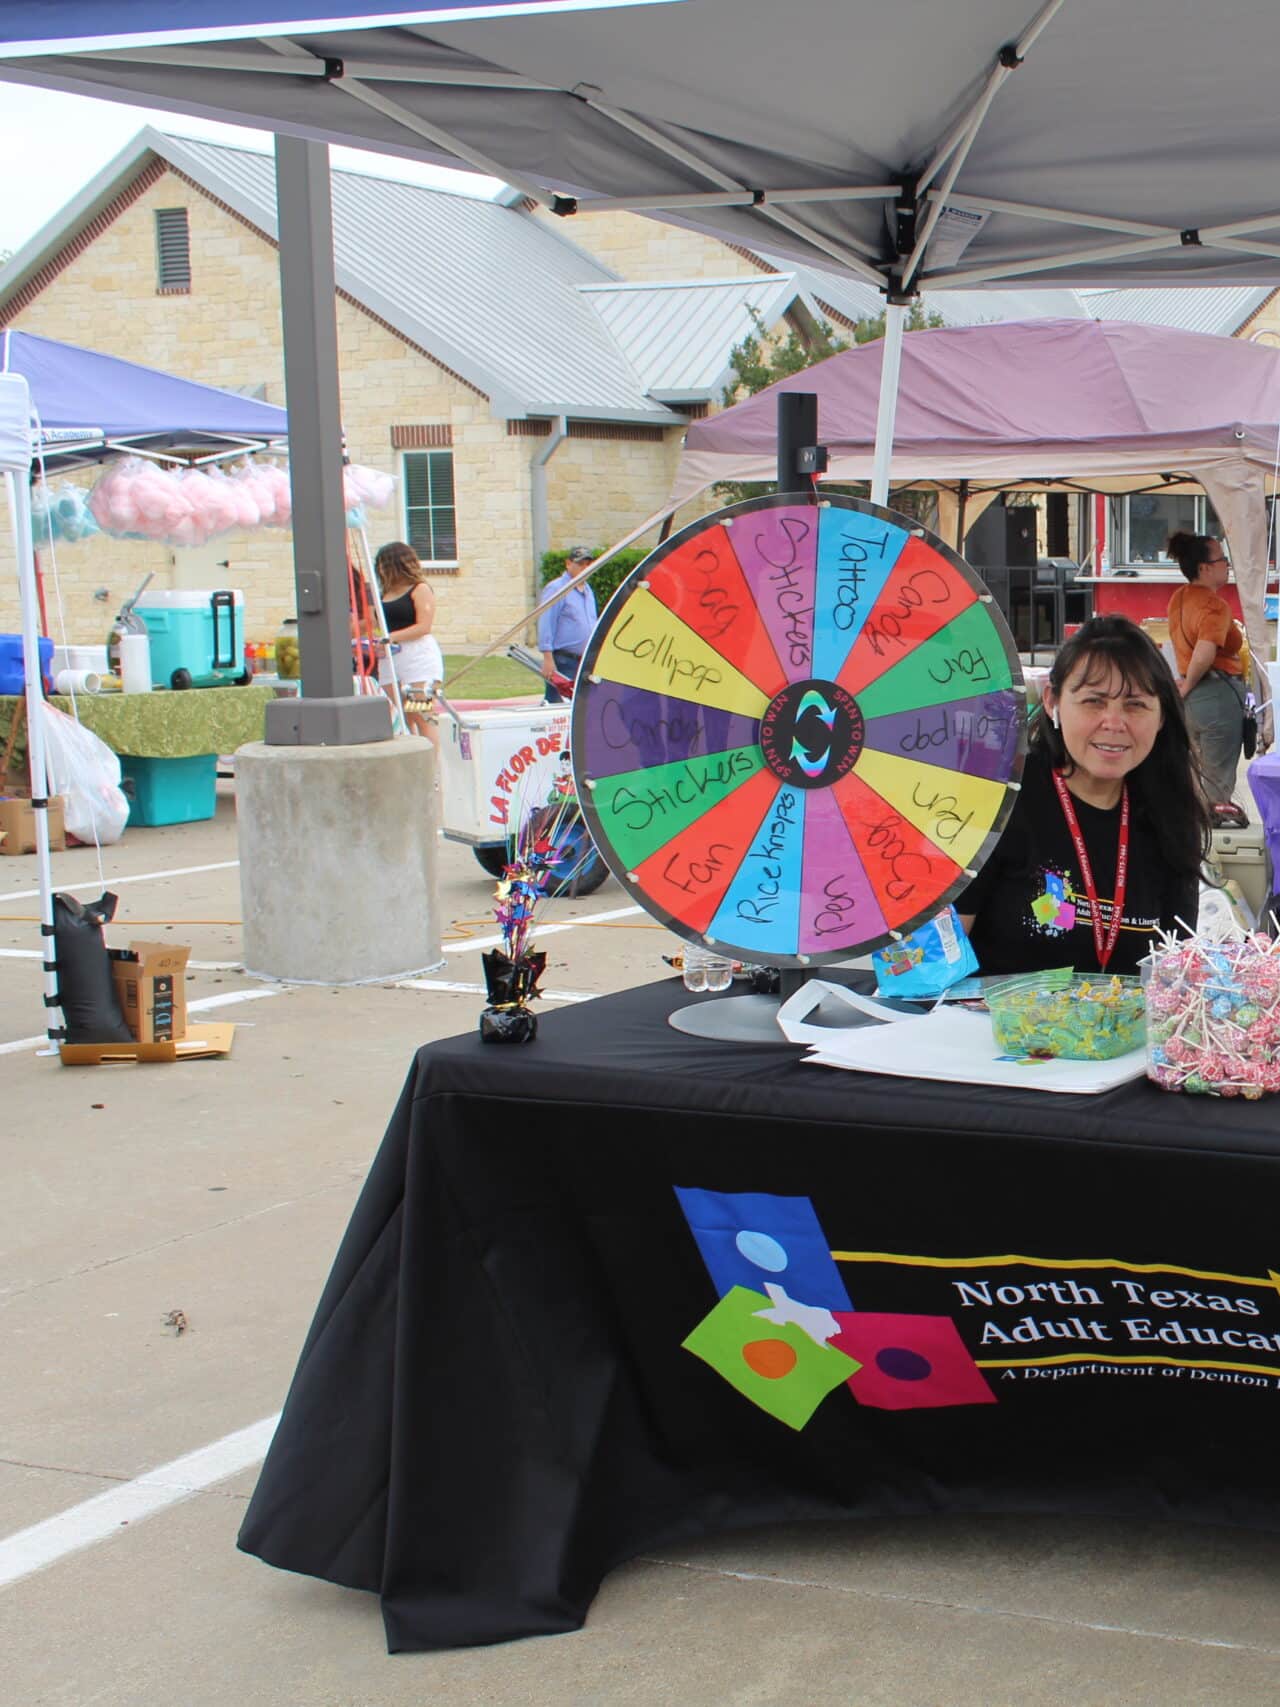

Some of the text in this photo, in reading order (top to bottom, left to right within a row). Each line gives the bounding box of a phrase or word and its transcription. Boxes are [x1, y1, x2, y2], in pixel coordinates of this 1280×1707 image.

[833, 532, 889, 631] Tattoo
[613, 614, 723, 691] Lollipop
[928, 647, 991, 684] Fan
[535, 732, 561, 757] DE
[762, 694, 792, 778] SPIN TO WIN
[833, 690, 863, 773] SPIN TO WIN
[495, 745, 538, 794] FLOR
[612, 752, 754, 830] Stickers
[489, 795, 510, 825] LA
[912, 782, 975, 845] Pen
[736, 864, 783, 924] Rice
[814, 874, 855, 937] Pen
[951, 1280, 1260, 1316] North Texas
[979, 1316, 1113, 1345] Adult
[1001, 1367, 1016, 1380] A
[1024, 1363, 1154, 1381] Department
[1161, 1366, 1184, 1378] of
[1190, 1368, 1269, 1388] Denton
